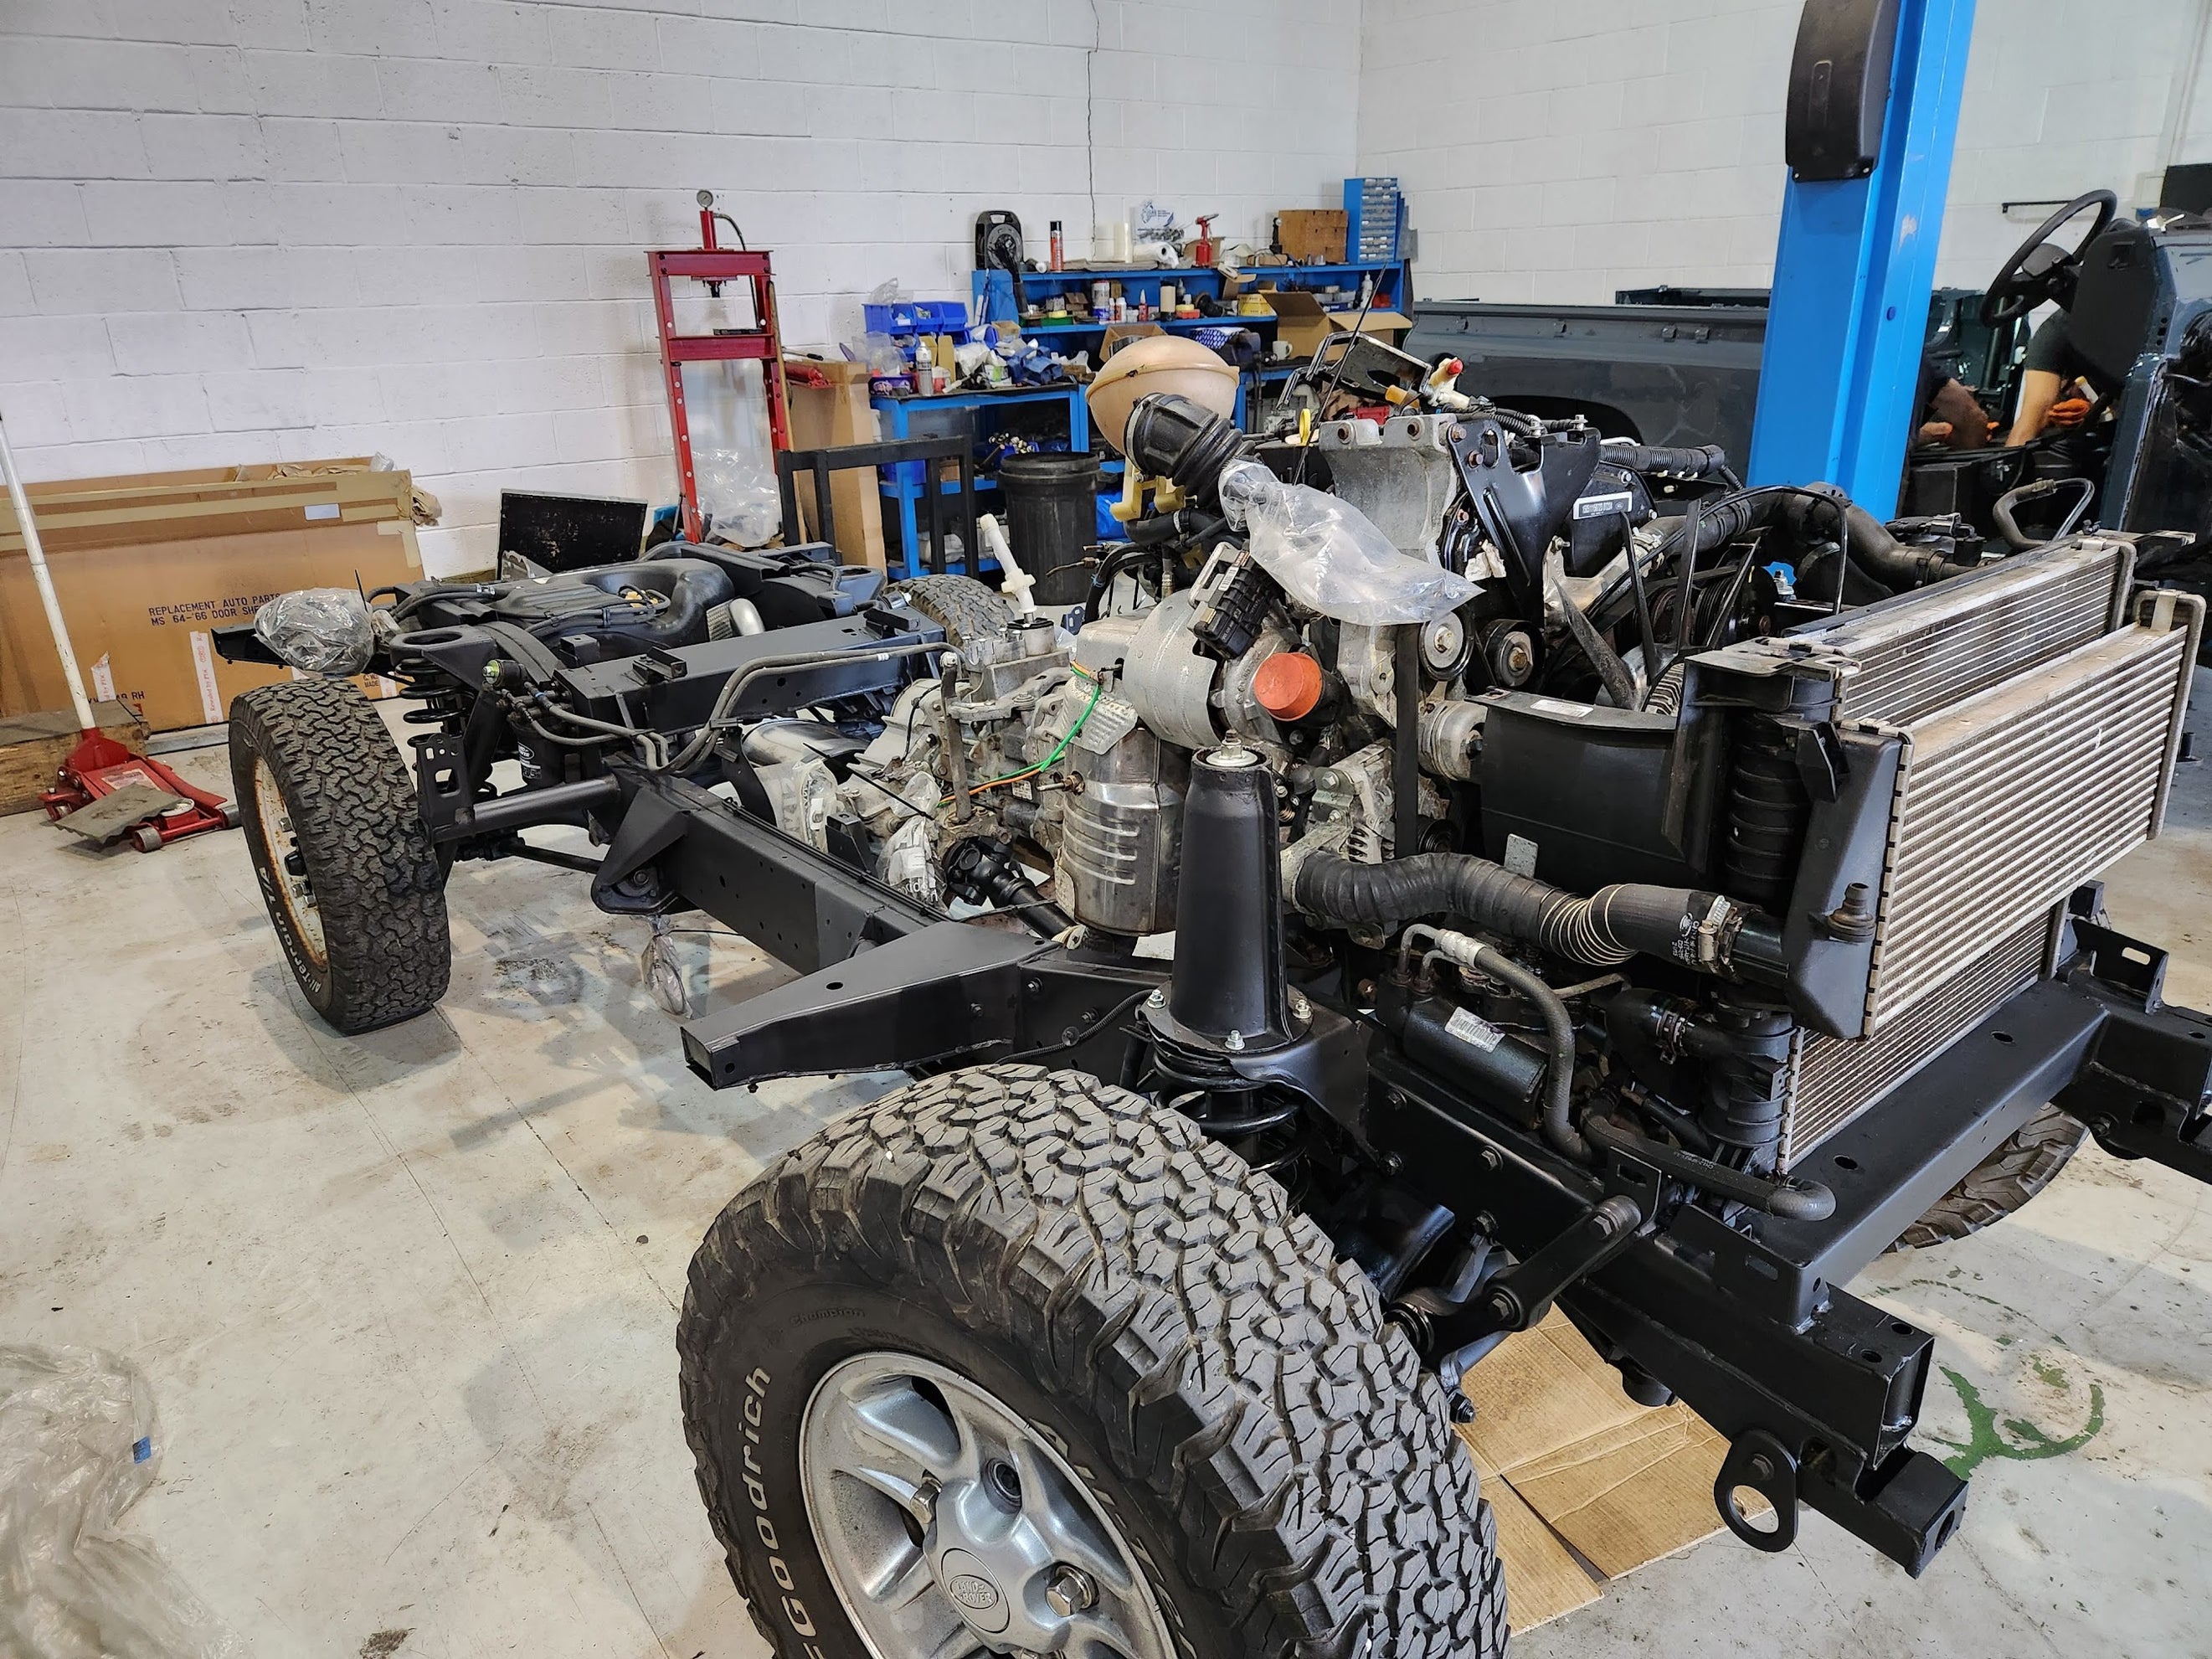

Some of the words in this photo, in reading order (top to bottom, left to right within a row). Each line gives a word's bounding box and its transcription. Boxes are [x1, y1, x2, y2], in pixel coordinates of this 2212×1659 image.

[148, 600, 216, 616] REPLACEMENT
[223, 597, 248, 607] AUTO
[151, 617, 166, 626] MS
[212, 609, 237, 619] DOOR
[131, 691, 145, 700] RH
[961, 1591, 992, 1604] ROVER
